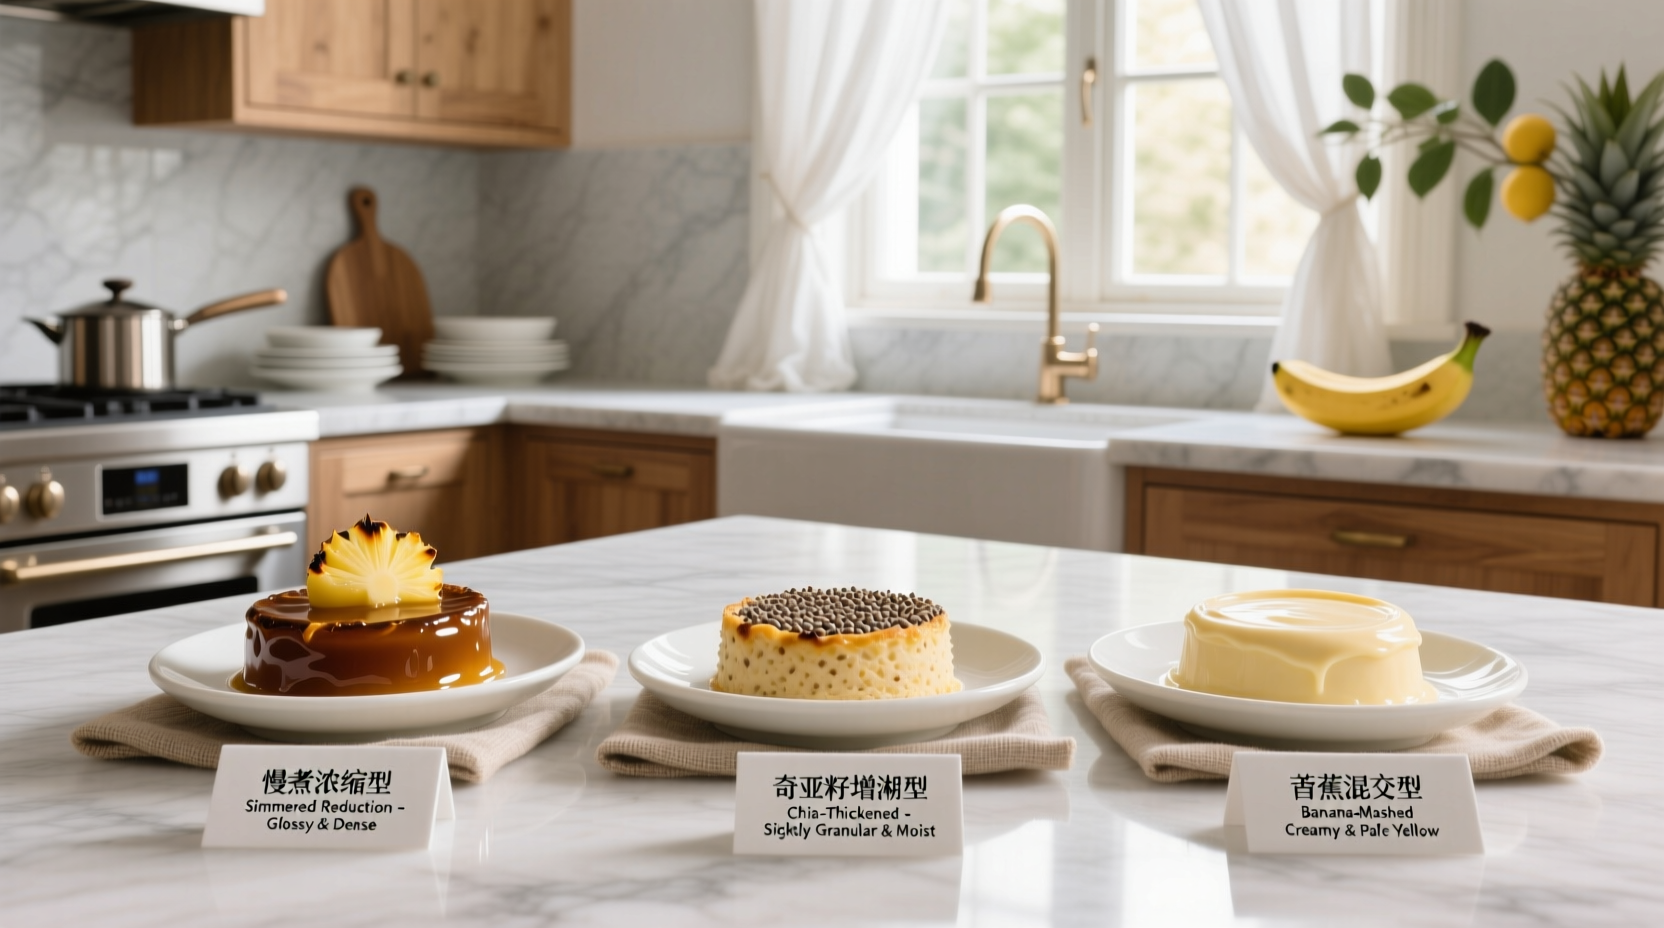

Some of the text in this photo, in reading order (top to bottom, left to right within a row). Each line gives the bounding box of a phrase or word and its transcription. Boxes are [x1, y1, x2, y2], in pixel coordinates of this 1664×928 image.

[244, 798, 318, 813] Simmered
[320, 799, 393, 814] Reduction
[786, 805, 900, 821] Chia-Thickened
[1301, 804, 1414, 820] Banana-Mashed
[266, 816, 378, 835] Glossy & Dense
[815, 822, 879, 838] Granular
[880, 823, 893, 838] &
[896, 823, 936, 838] Moist
[1284, 822, 1341, 841] Creamy
[1344, 823, 1357, 837] &
[1391, 822, 1440, 838] Yellow
